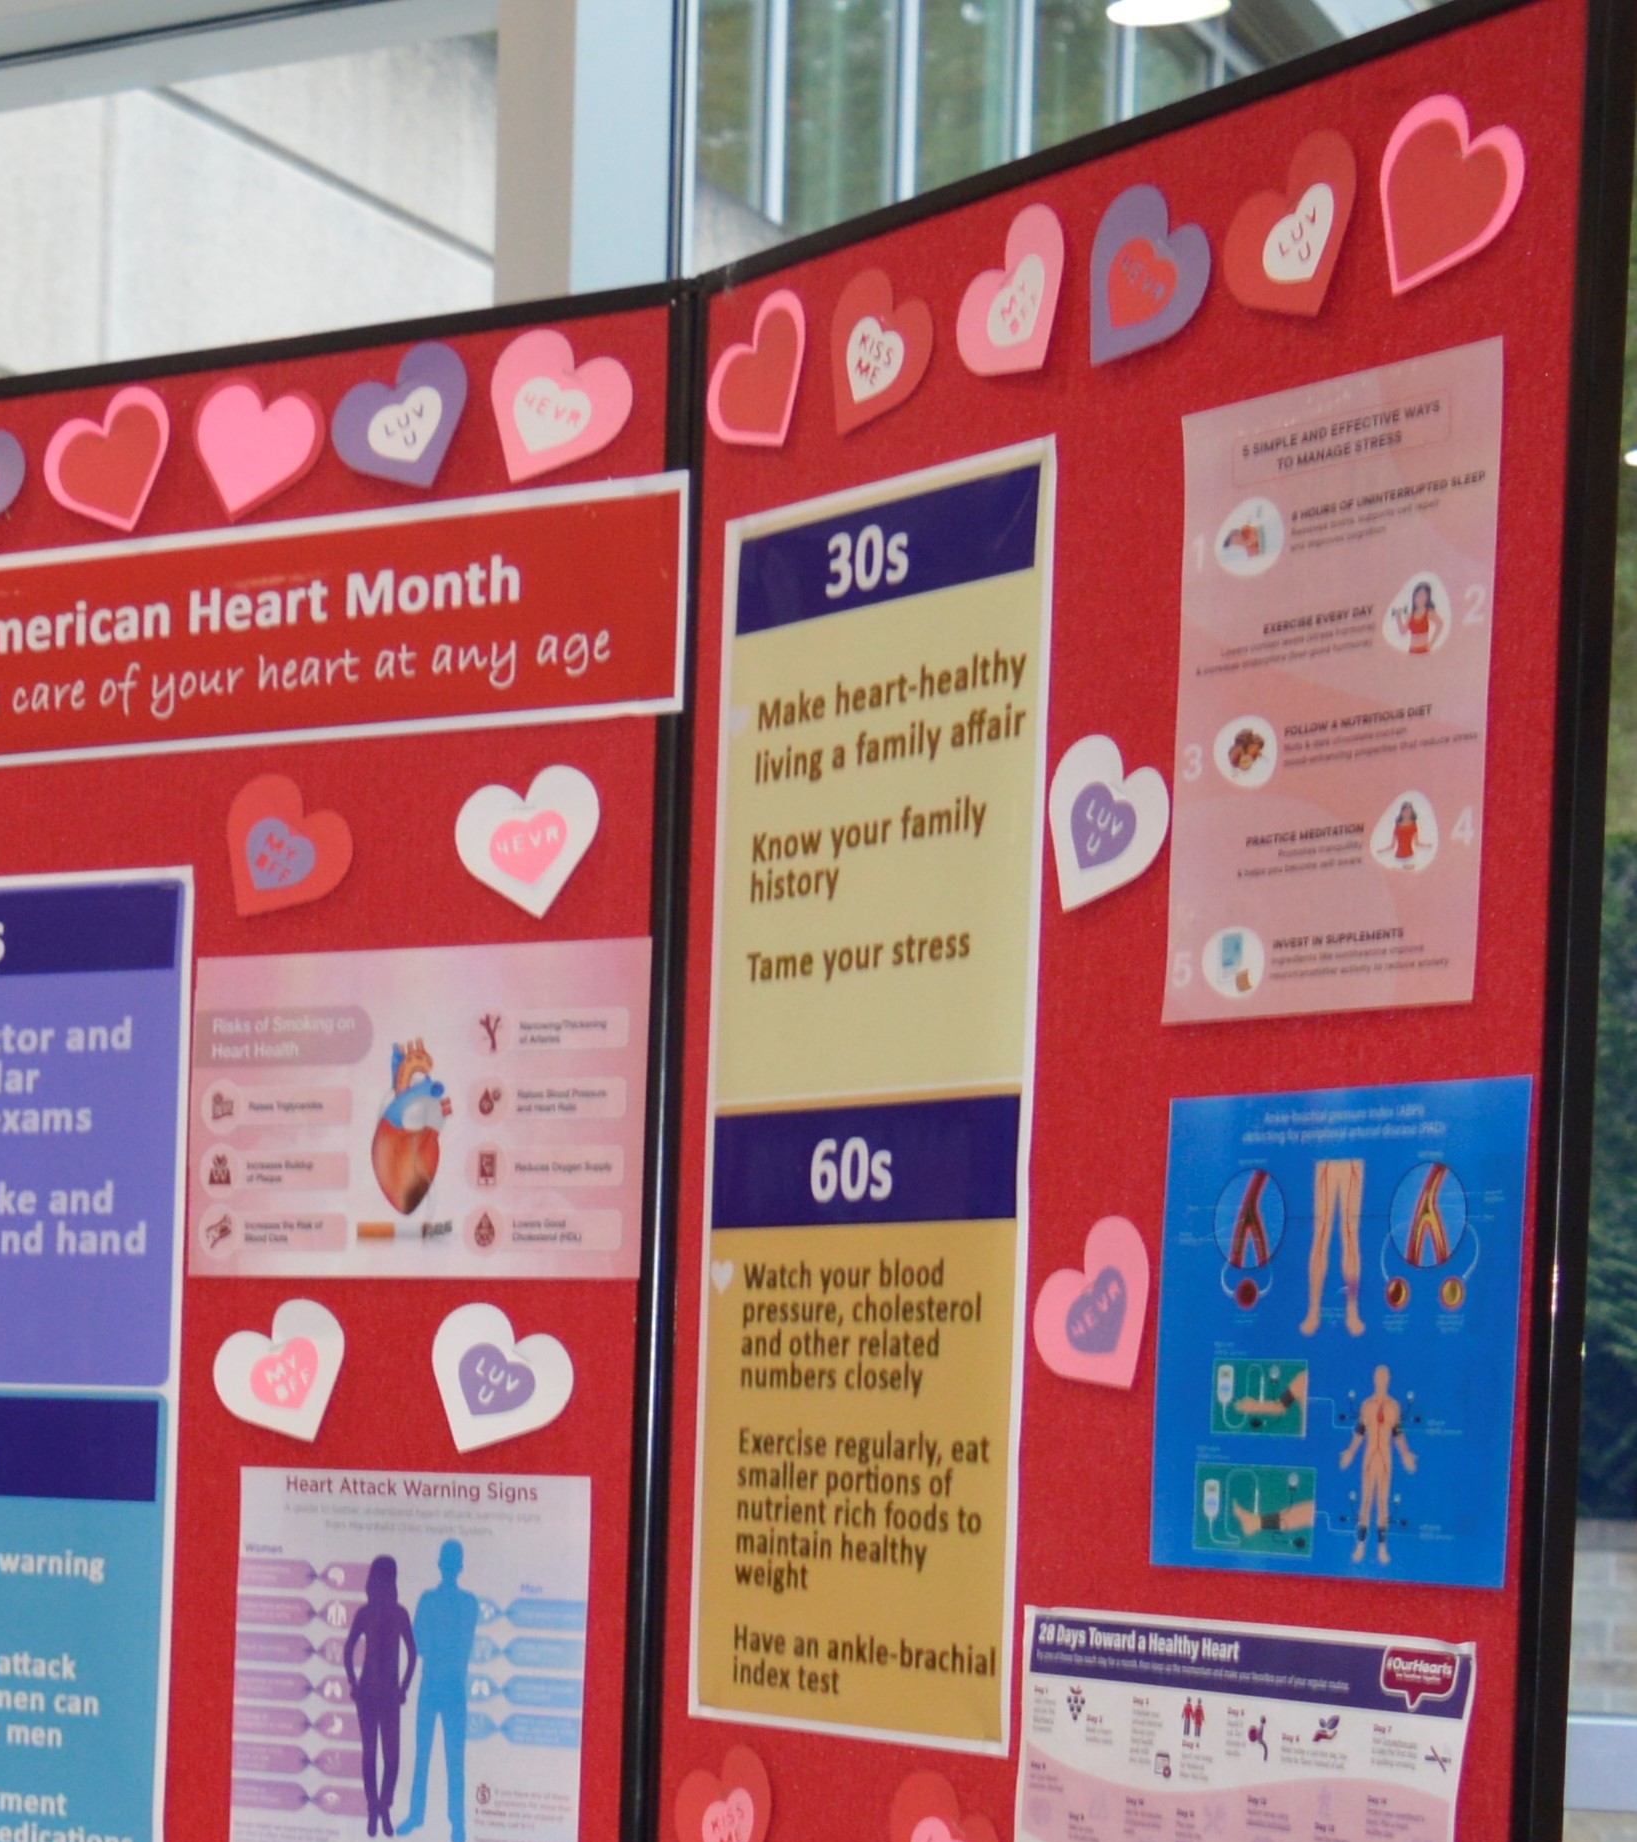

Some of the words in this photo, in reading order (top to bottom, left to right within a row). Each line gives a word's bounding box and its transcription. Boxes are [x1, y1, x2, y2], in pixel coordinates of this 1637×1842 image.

[826, 525, 908, 597] 30s
[190, 580, 328, 633] Heart
[347, 555, 520, 618] Month
[13, 680, 85, 713] care
[99, 662, 140, 715] of
[151, 667, 244, 719] your
[258, 649, 359, 690] heart
[375, 644, 416, 679] at
[432, 641, 517, 689] any
[537, 630, 610, 676] age
[758, 691, 825, 731] Make
[836, 649, 1026, 716] heart-healthy
[756, 746, 823, 784] living
[831, 741, 846, 770] a
[856, 721, 941, 765] family
[951, 703, 1026, 748] affair
[753, 830, 821, 863] Know
[831, 819, 891, 859] your
[901, 796, 986, 840] family
[751, 868, 839, 903] history
[748, 953, 813, 982] Tame
[823, 944, 883, 982] your
[893, 933, 970, 966] stress
[66, 1016, 132, 1051] and
[811, 1137, 892, 1202] 60s
[744, 1262, 811, 1289] Watch
[821, 1268, 870, 1294] your
[880, 1259, 944, 1287] blood
[476, 1358, 519, 1391] LUV
[478, 1386, 494, 1404] U
[287, 1477, 332, 1493] Heart
[340, 1478, 396, 1495] Attack
[404, 1480, 480, 1502] Warning
[488, 1482, 537, 1503] Signs
[734, 1625, 785, 1655] Have
[791, 1634, 819, 1660] an
[827, 1635, 995, 1676] ankle-brachial
[1057, 1622, 1086, 1648] Days
[1087, 1625, 1136, 1650] Toward
[1149, 1635, 1198, 1659] Healthy
[1202, 1639, 1239, 1659] Heart
[733, 1656, 789, 1688] index
[798, 1666, 839, 1694] test
